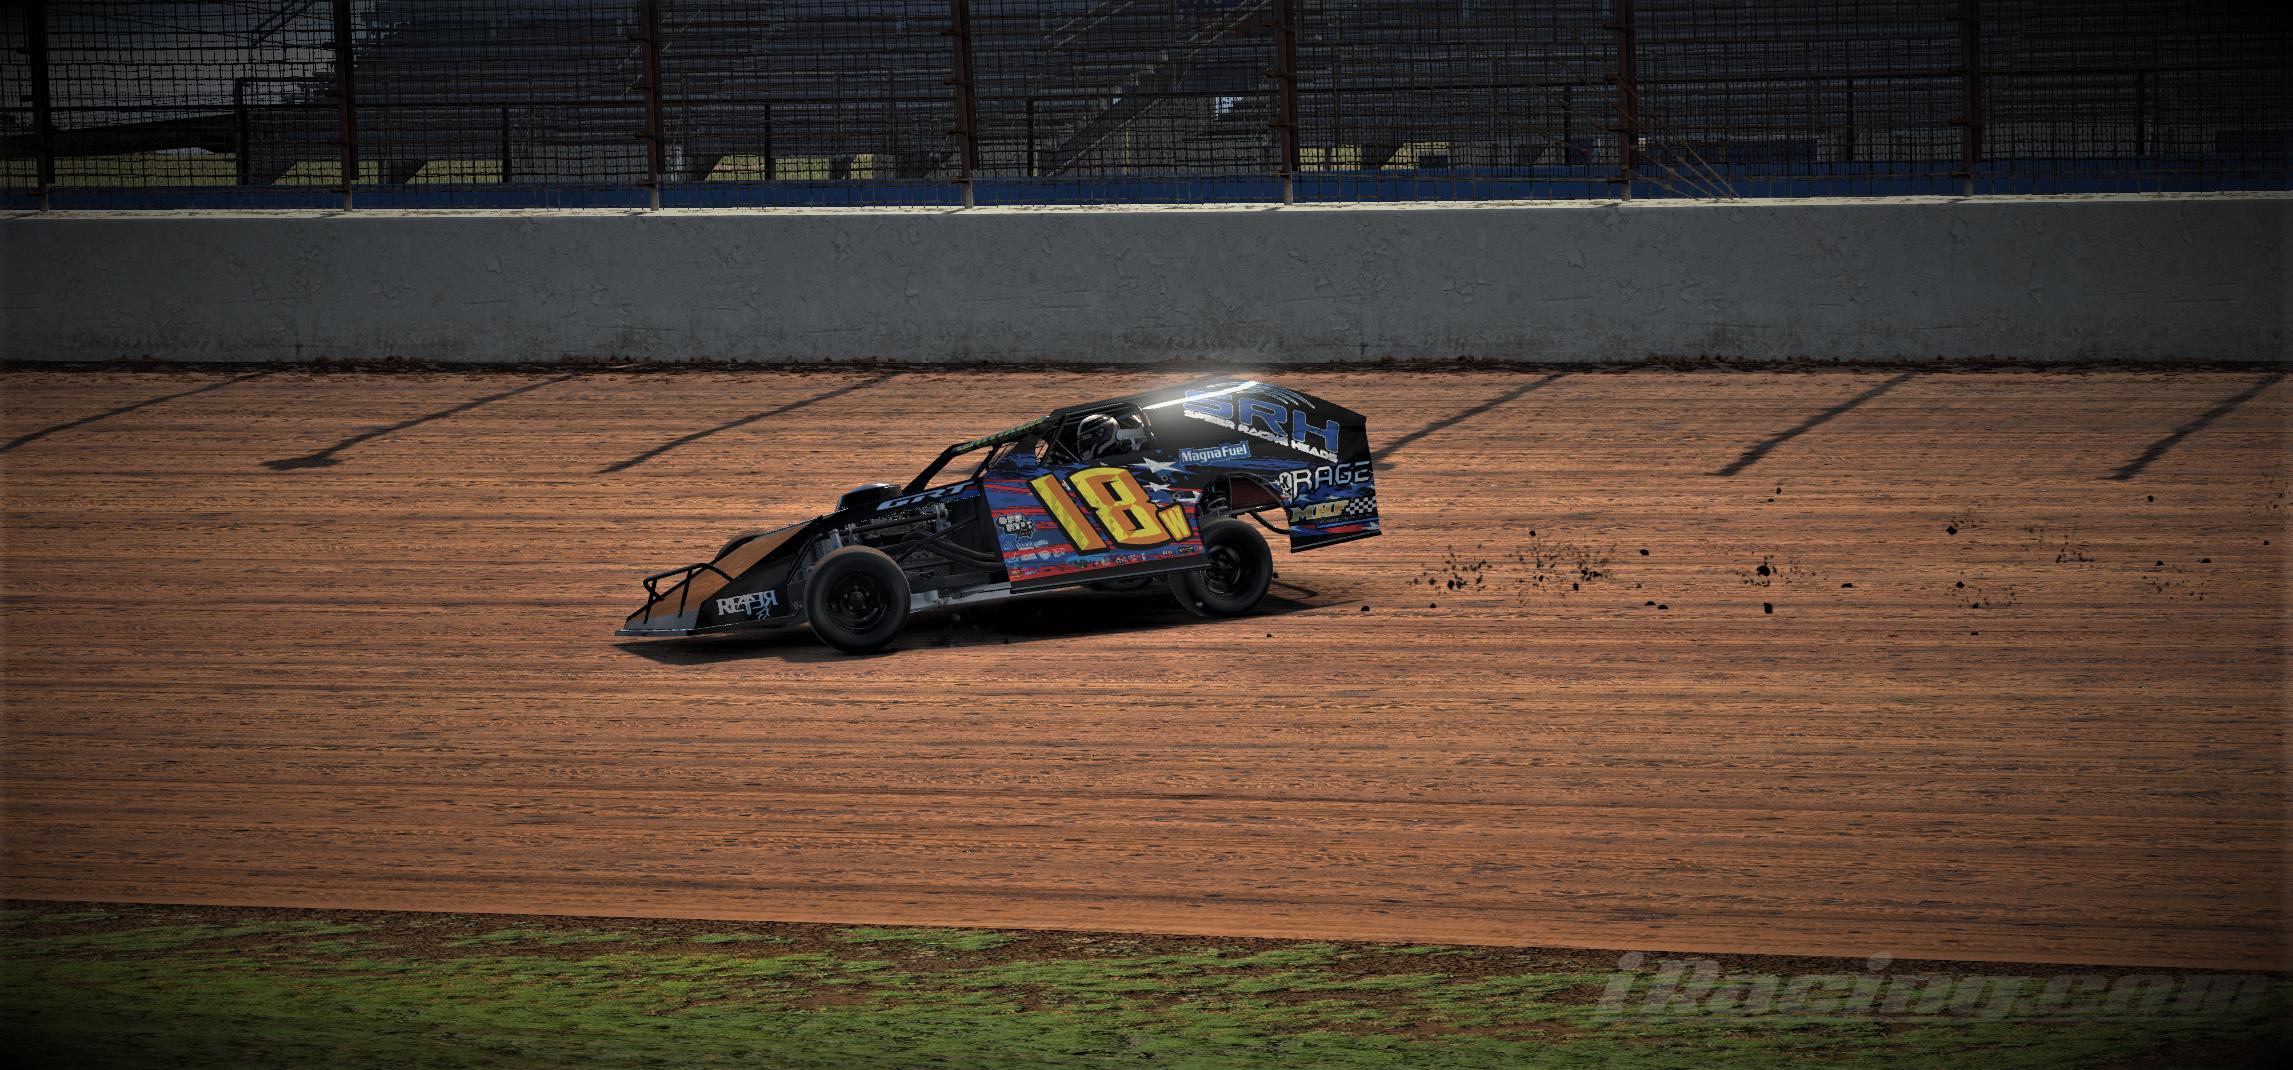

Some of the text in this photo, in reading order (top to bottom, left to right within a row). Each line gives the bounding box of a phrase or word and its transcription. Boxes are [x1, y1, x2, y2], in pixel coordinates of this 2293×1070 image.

[1183, 389, 1341, 454] SRH
[1181, 442, 1248, 464] MagnaFuel
[876, 480, 976, 511] GRT
